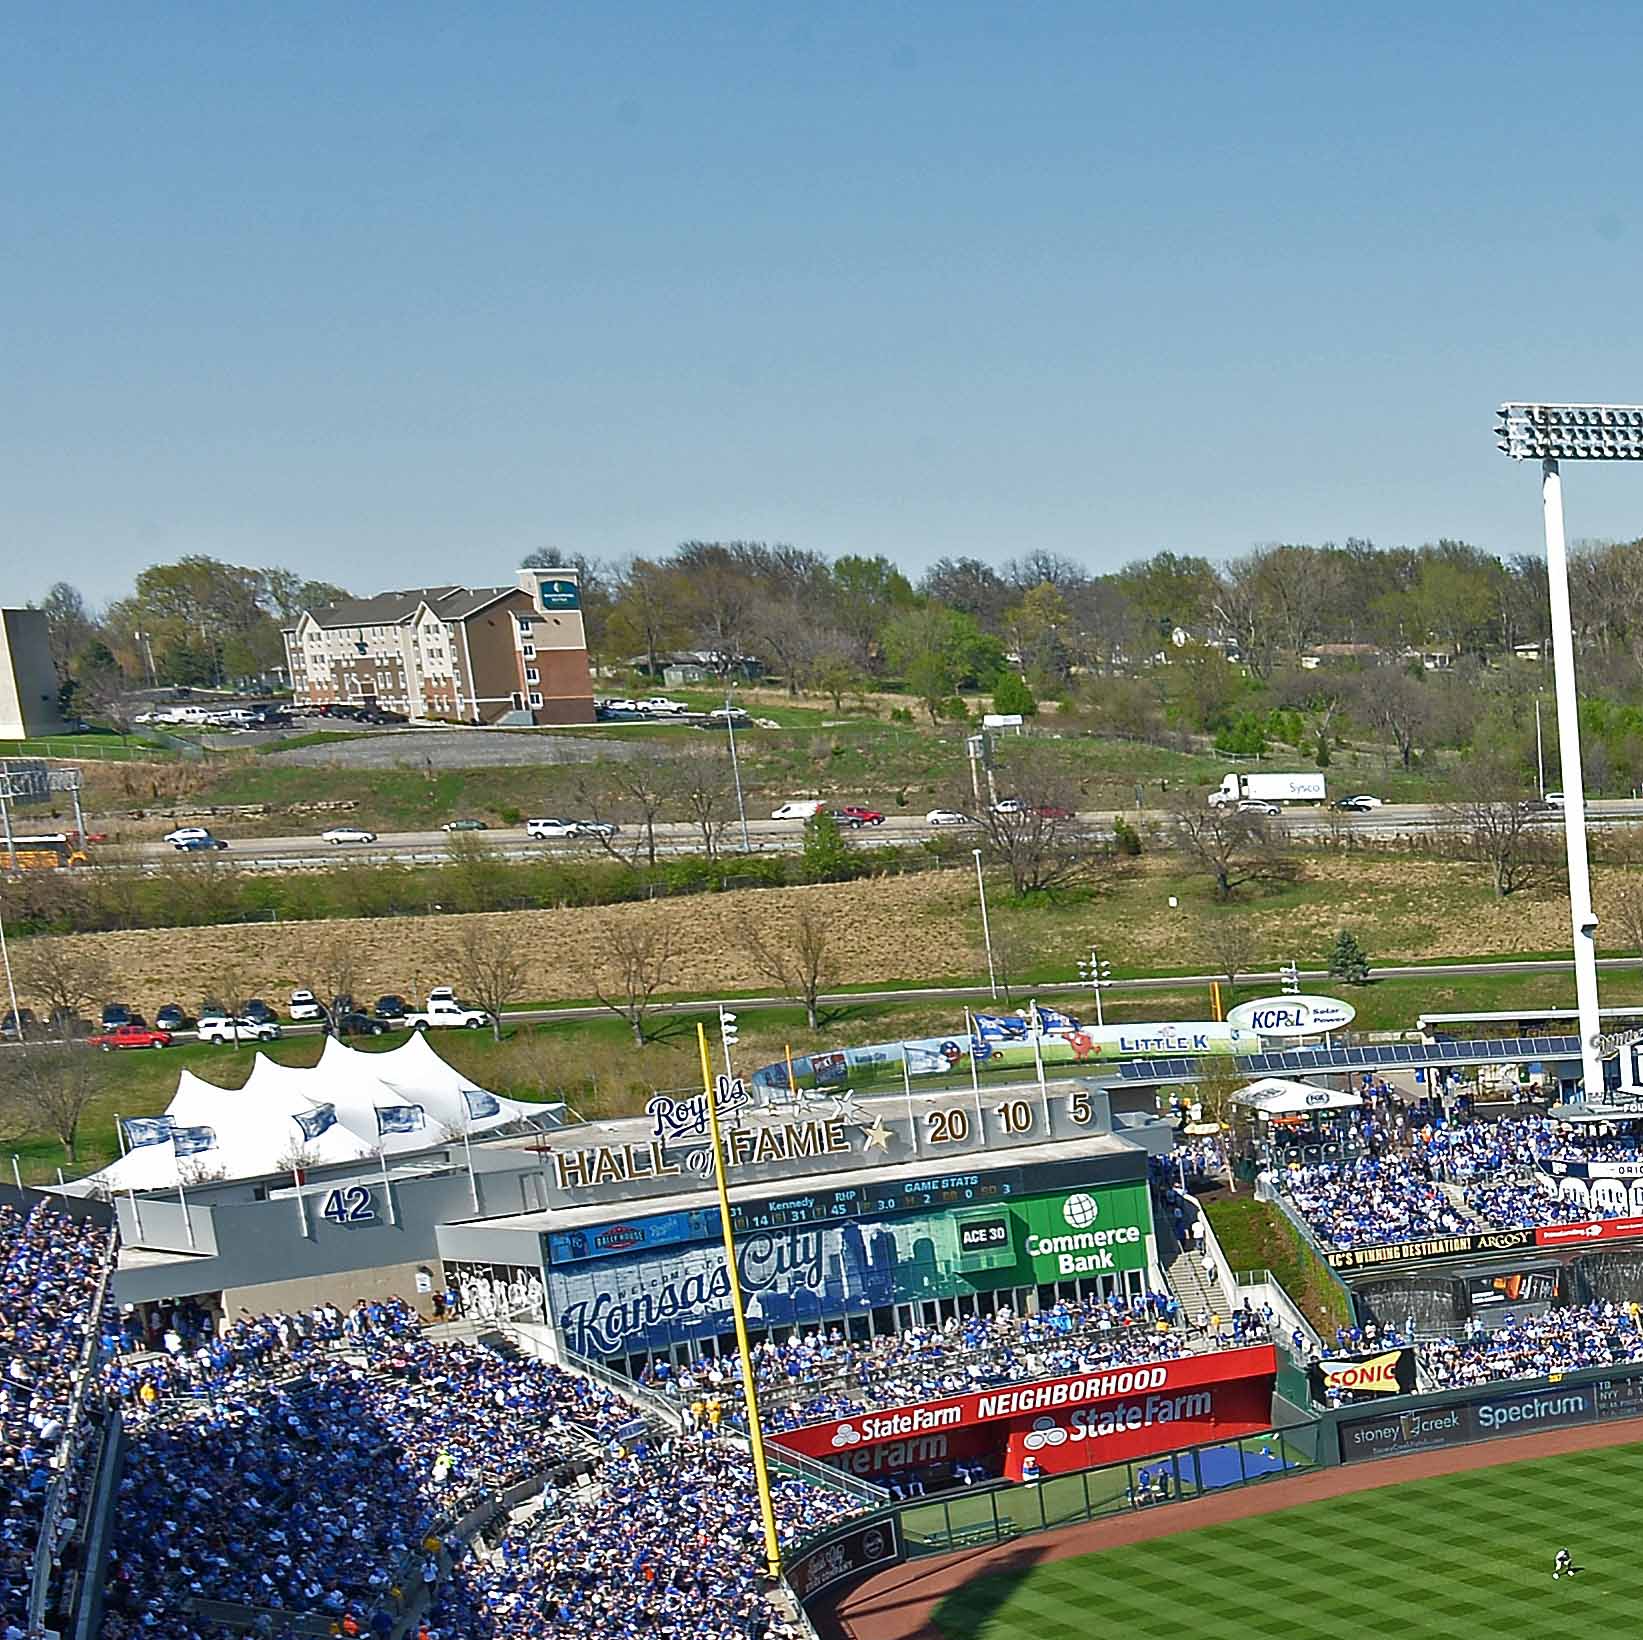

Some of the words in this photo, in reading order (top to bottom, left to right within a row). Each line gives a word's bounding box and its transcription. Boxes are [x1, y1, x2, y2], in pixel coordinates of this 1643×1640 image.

[1289, 782, 1321, 794] Sysco
[1251, 1008, 1305, 1030] KCP&L
[1119, 1036, 1190, 1054] LITTLE
[1193, 1033, 1210, 1052] K
[926, 1107, 970, 1145] 20
[993, 1099, 1034, 1135] 10
[1068, 1091, 1093, 1126] 5
[556, 1141, 681, 1190] HALL
[728, 1116, 854, 1168] FAME
[904, 1180, 940, 1194] GAME
[941, 1175, 979, 1190] STATS
[320, 1185, 375, 1224] 42
[753, 1214, 769, 1227] 14
[792, 1209, 807, 1222] 31
[831, 1203, 848, 1215] 45
[878, 1199, 896, 1211] 3.0
[923, 1193, 931, 1204] 2
[965, 1189, 973, 1200] 0
[1003, 1184, 1011, 1195] 3
[769, 1198, 815, 1212] Kennedy
[835, 1190, 857, 1203] RHP
[962, 1228, 988, 1244] ACE
[988, 1226, 1005, 1241] 30
[1027, 1225, 1140, 1256] Commerce
[1477, 1232, 1530, 1252] ARGOSY
[1059, 1247, 1114, 1275] Bank
[1355, 1246, 1401, 1264] WINNING
[1402, 1237, 1472, 1259] DESTINATION!
[560, 1264, 734, 1356] Kansas
[737, 1230, 825, 1298] City
[1329, 1363, 1398, 1388] SONIC
[977, 1366, 1169, 1420] NEIGHBORHOOD
[1600, 1389, 1619, 1401] NYY
[1478, 1395, 1584, 1430] Spectrum
[1353, 1424, 1401, 1444] stoney
[1421, 1411, 1460, 1433] creek
